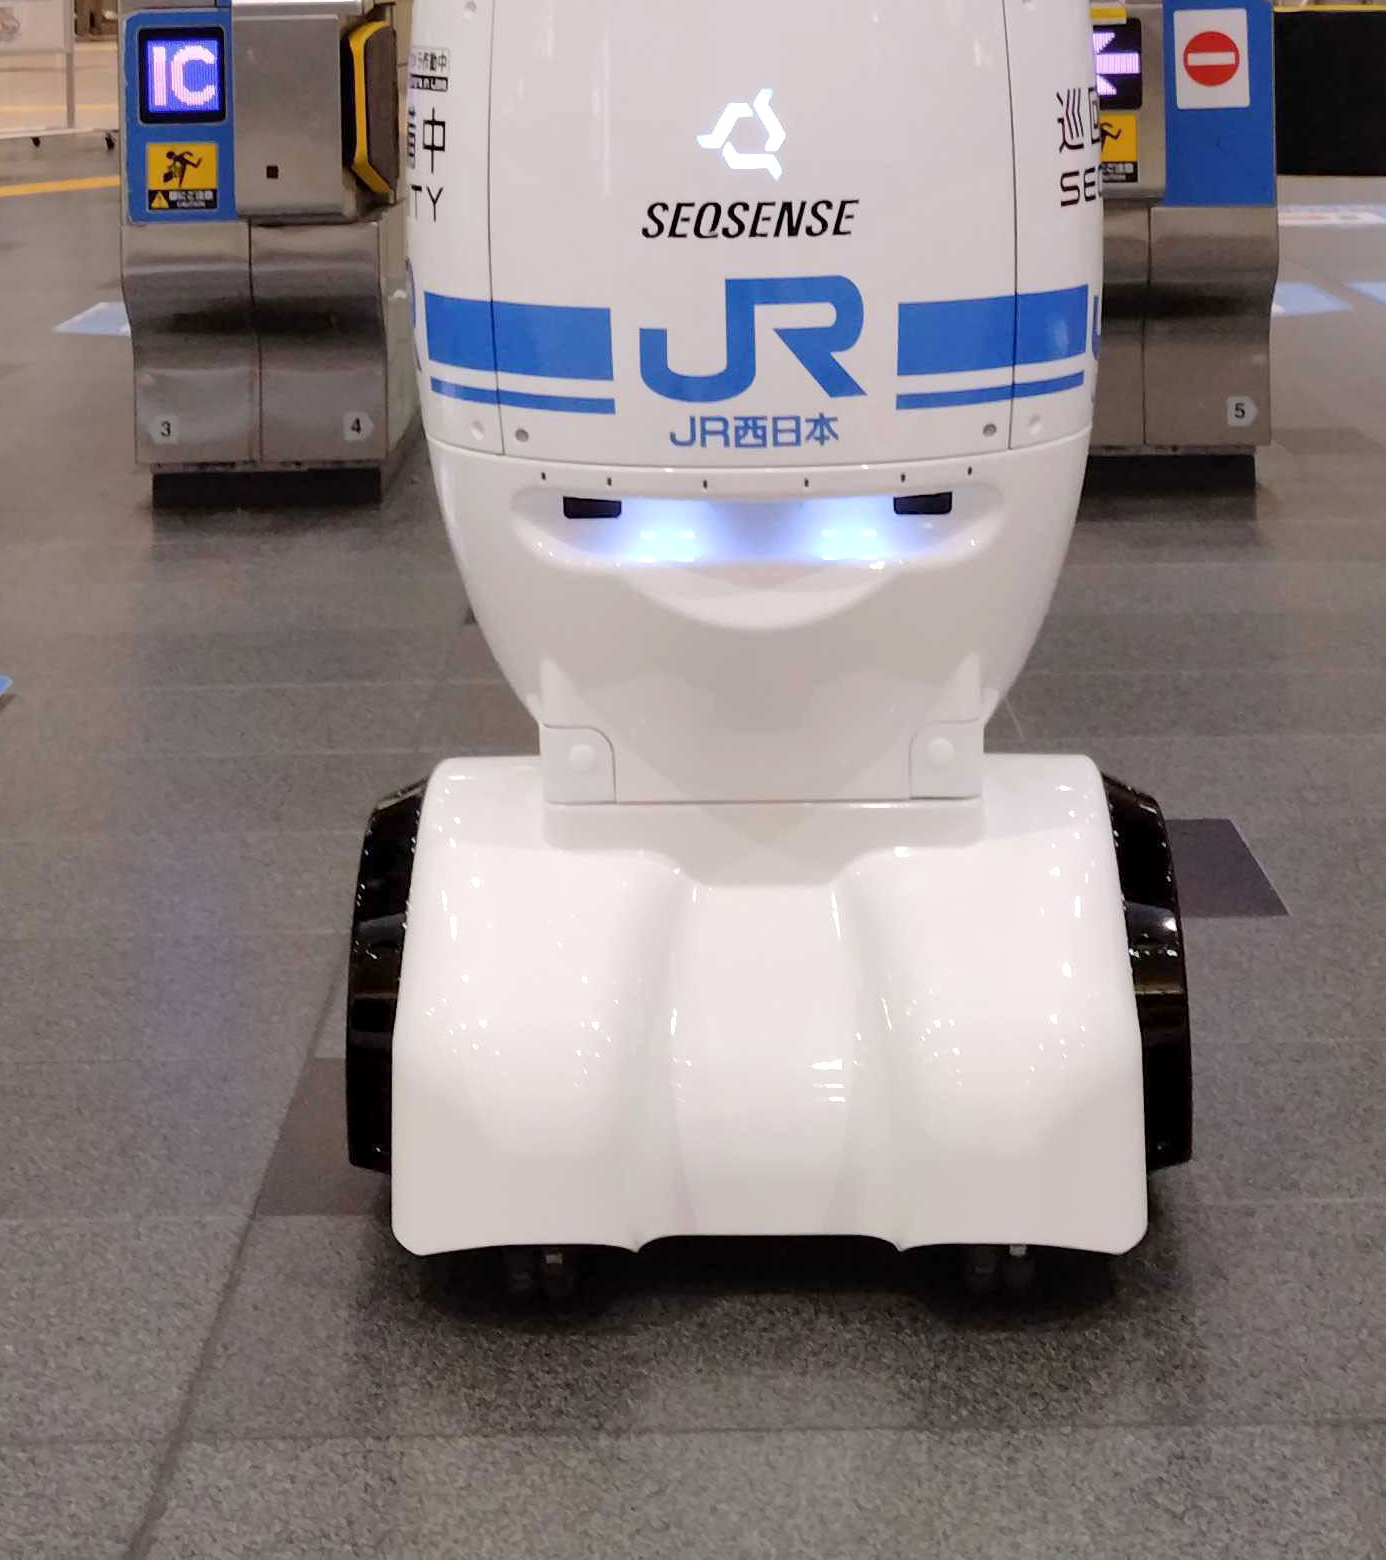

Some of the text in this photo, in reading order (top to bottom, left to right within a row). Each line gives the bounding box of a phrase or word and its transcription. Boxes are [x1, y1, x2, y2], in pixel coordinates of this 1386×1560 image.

[152, 43, 217, 107] IC
[641, 199, 860, 240] SEQSENSE
[639, 275, 868, 403] JR
[350, 418, 362, 434] 4
[1234, 403, 1245, 419] 5
[160, 420, 172, 437] 3
[669, 415, 840, 449] JR西日本
